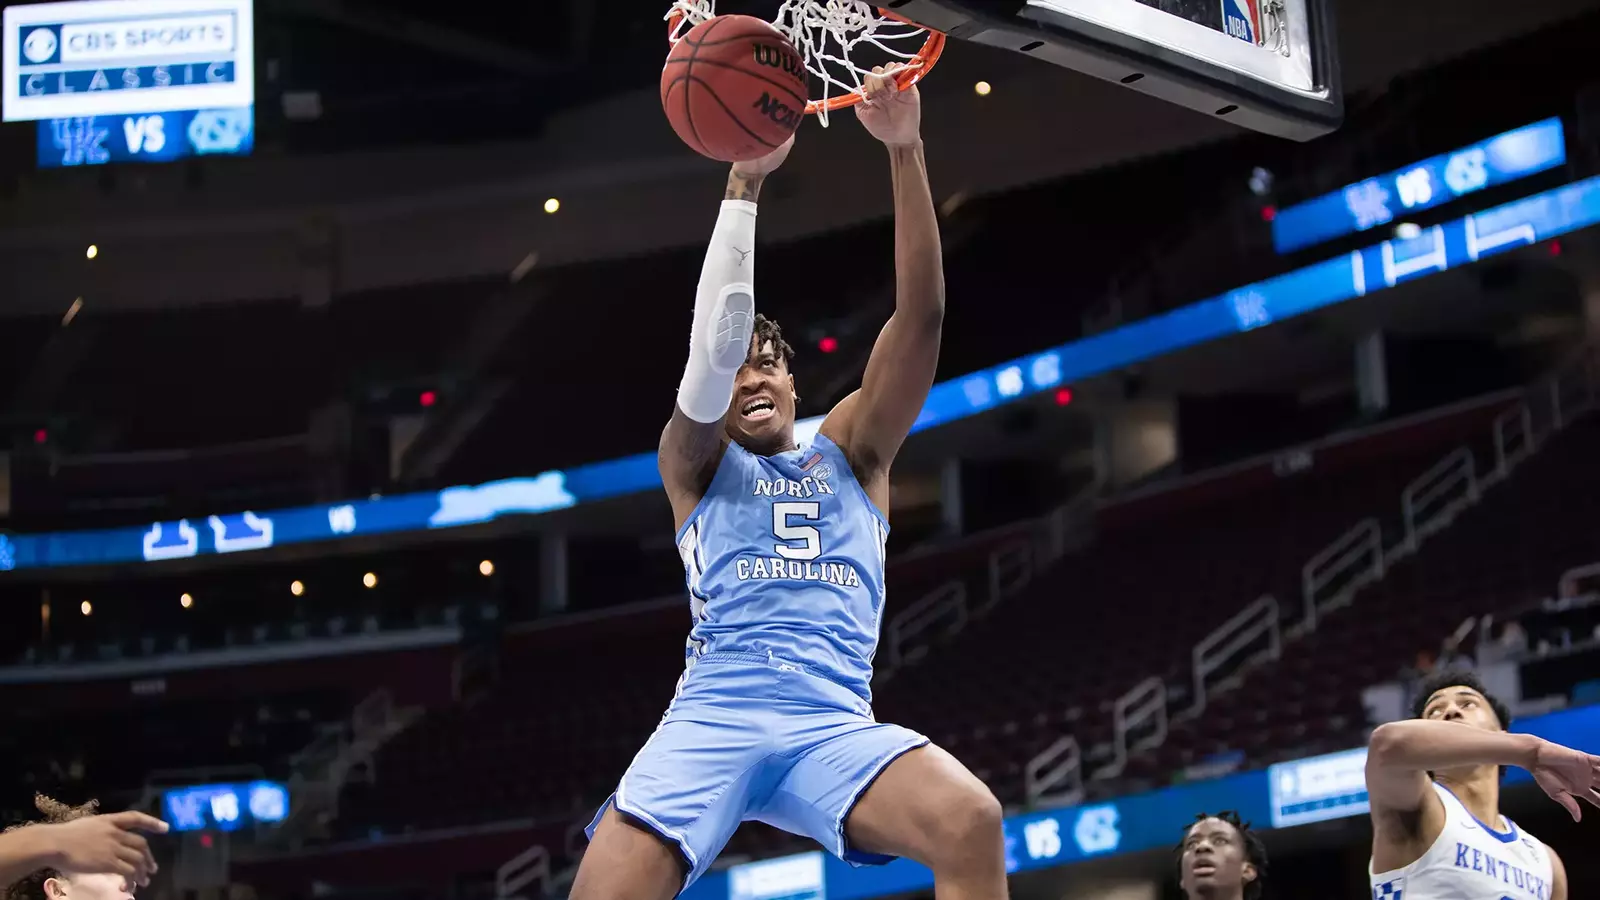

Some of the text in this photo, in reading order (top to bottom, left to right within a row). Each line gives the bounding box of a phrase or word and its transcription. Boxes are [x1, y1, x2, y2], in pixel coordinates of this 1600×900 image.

[69, 25, 225, 53] CBS SPORTS
[1227, 15, 1249, 40] NBA
[25, 63, 227, 97] CLASSIC
[123, 115, 165, 154] VS
[753, 477, 834, 498] NORTH
[772, 501, 822, 561] 5
[736, 557, 859, 588] CAROLINA
